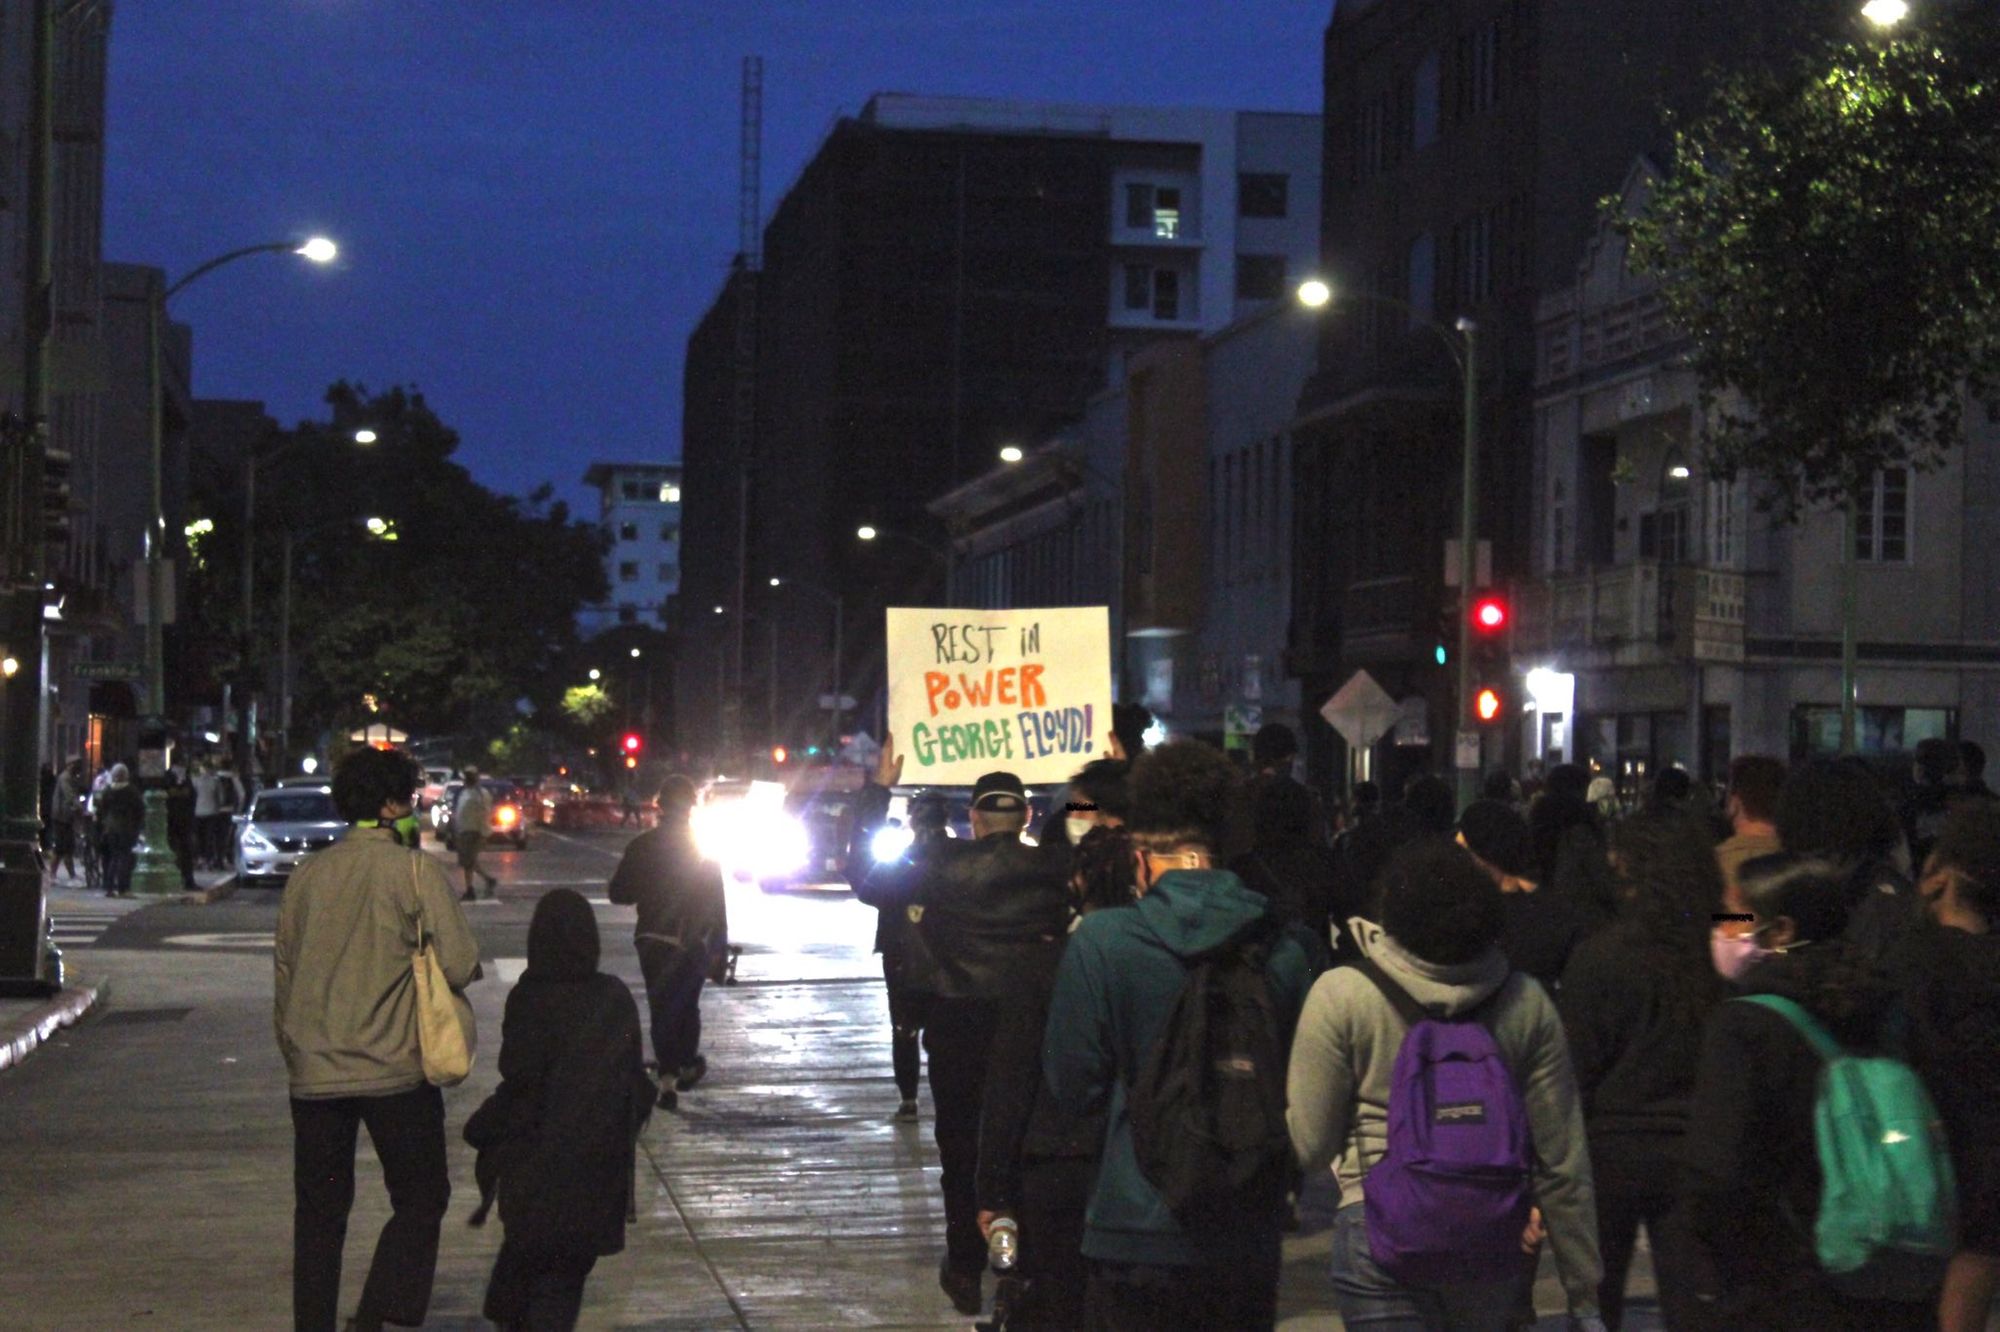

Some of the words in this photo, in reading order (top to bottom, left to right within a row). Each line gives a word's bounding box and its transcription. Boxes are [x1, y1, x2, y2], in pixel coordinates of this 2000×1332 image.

[931, 623, 1007, 664] REST
[924, 664, 1046, 717] POWER
[912, 718, 1013, 767] GEORGE
